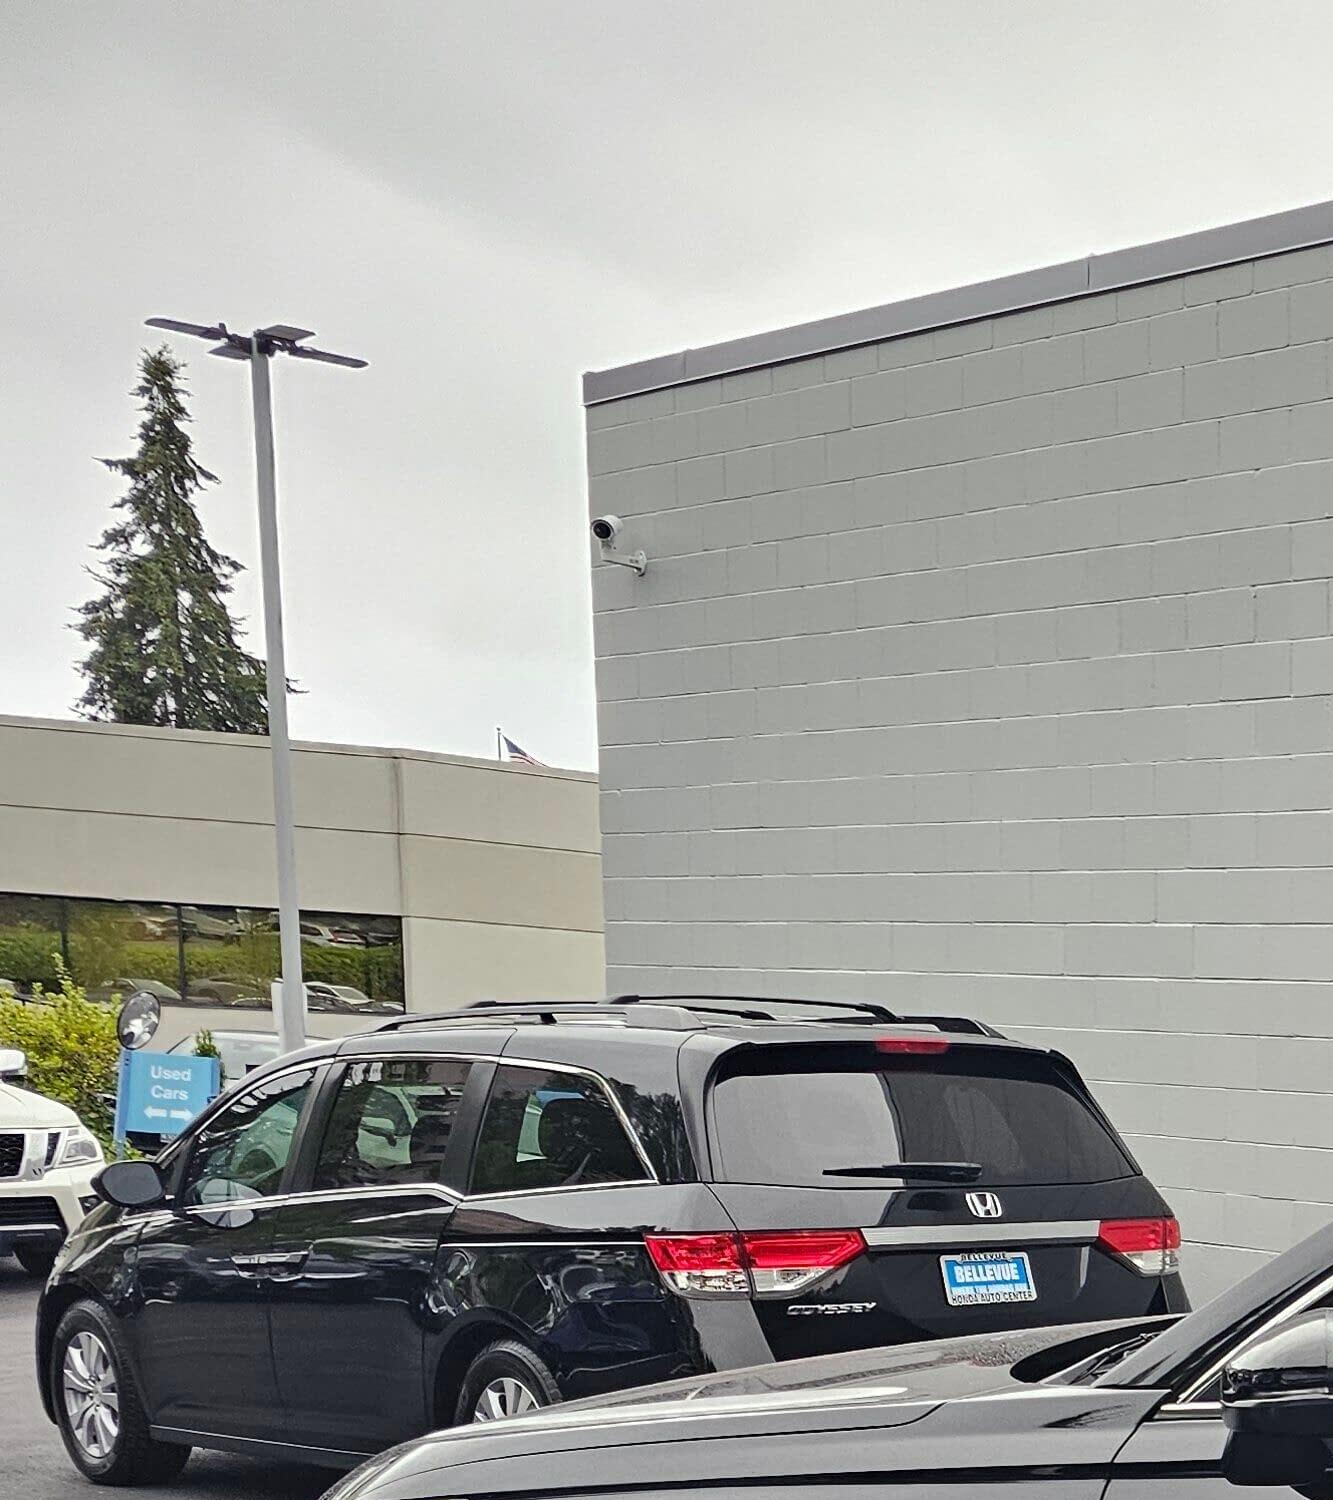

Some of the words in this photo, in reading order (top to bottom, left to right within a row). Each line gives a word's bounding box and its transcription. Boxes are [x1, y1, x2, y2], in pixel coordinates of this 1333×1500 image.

[151, 1065, 192, 1081] Used
[151, 1085, 189, 1100] Cars
[961, 1252, 1006, 1261] BELLEVUE
[954, 1263, 1020, 1283] BELLEVUE
[952, 1293, 978, 1304] HONDA
[980, 1292, 1001, 1303] AUTO
[1003, 1290, 1034, 1301] CENTER
[787, 1302, 877, 1315] ODYSSEY
